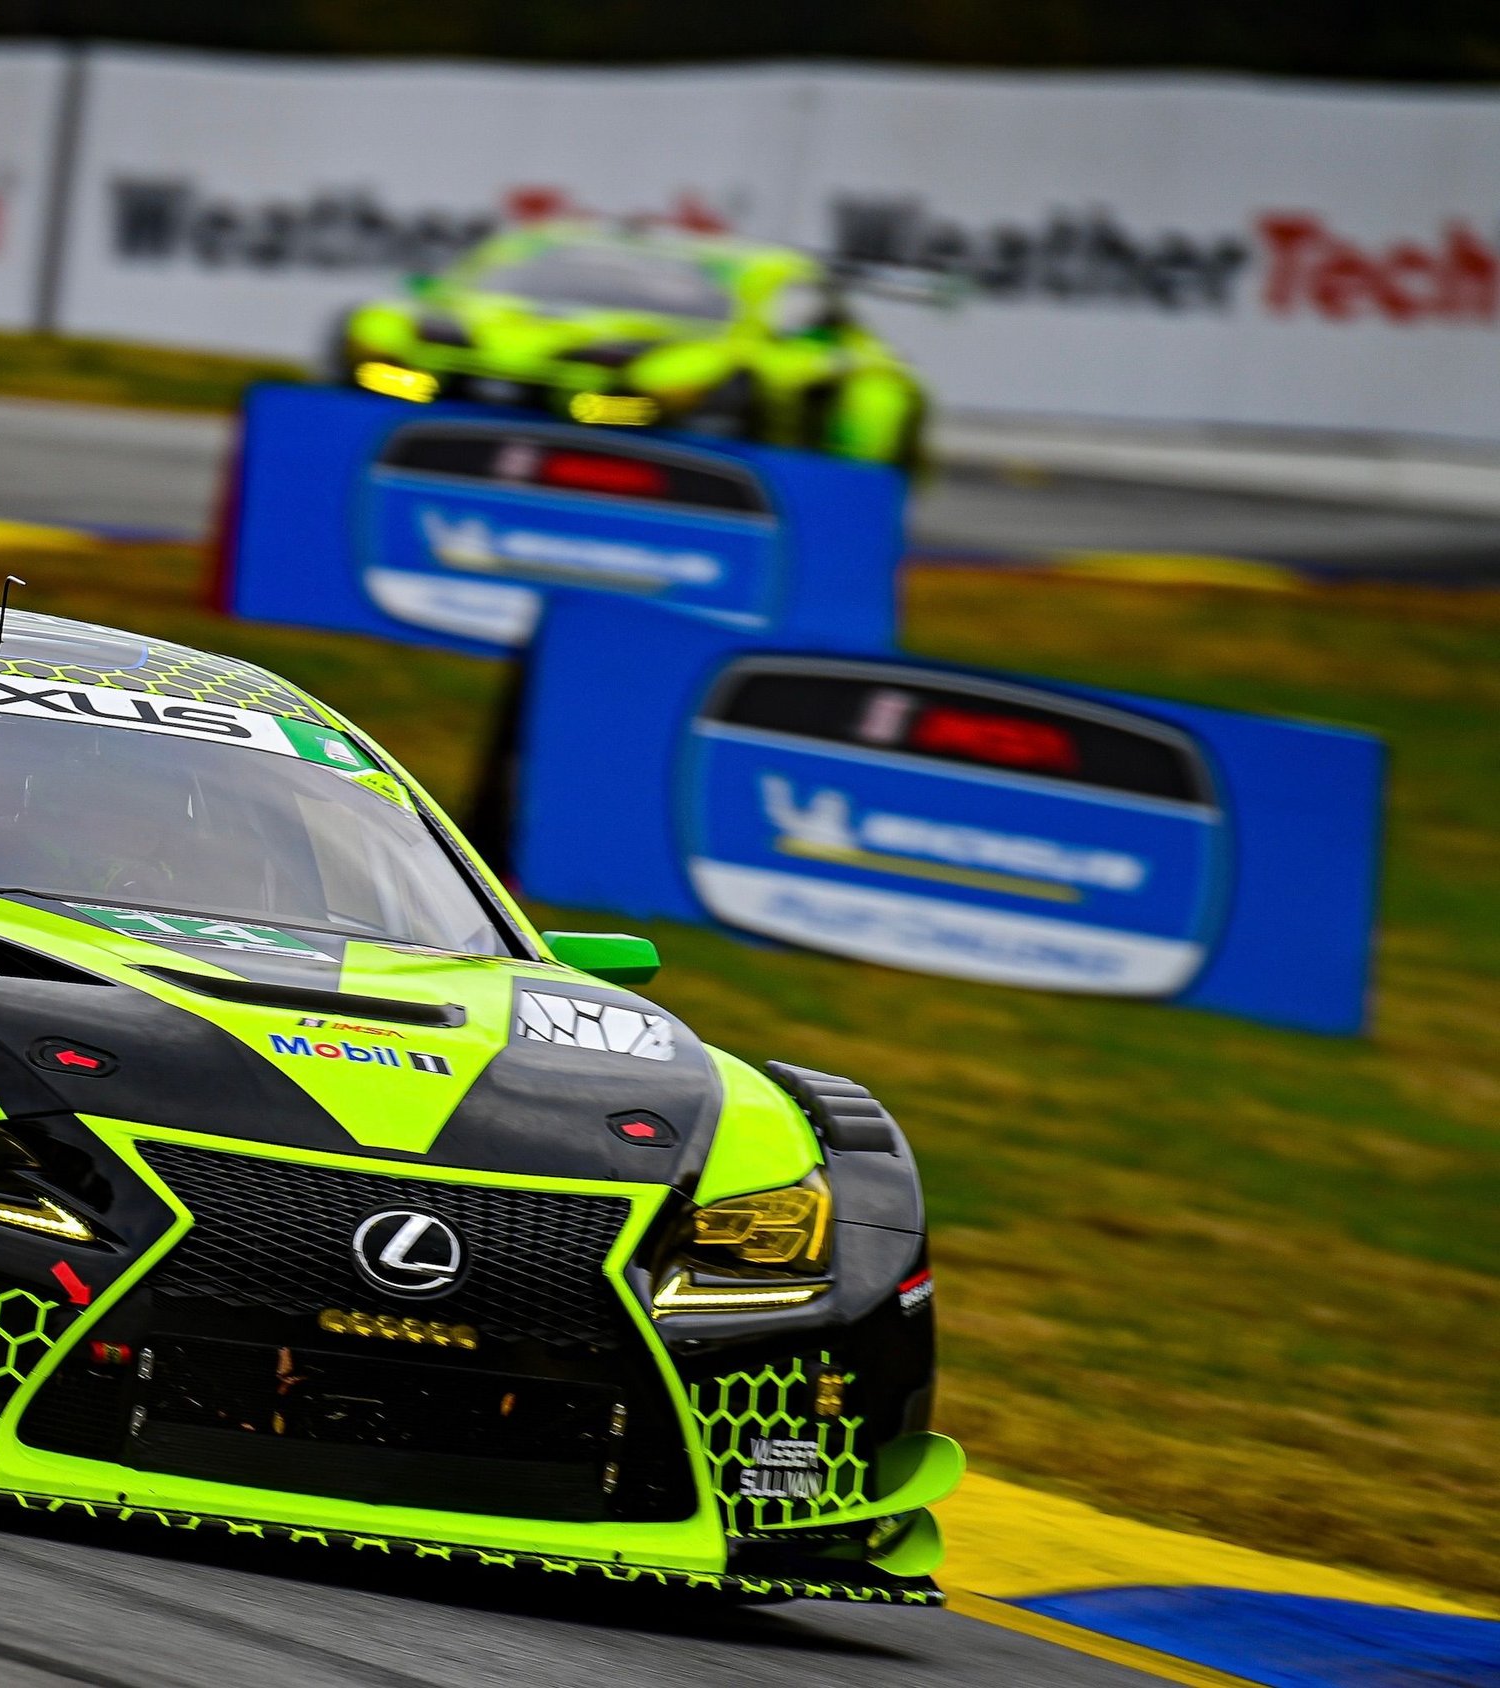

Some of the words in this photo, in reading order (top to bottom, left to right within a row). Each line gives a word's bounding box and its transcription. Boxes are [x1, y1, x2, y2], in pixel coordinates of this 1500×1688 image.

[112, 913, 279, 945] 14
[268, 1033, 401, 1068] Mobil
[410, 1052, 448, 1075] 1
